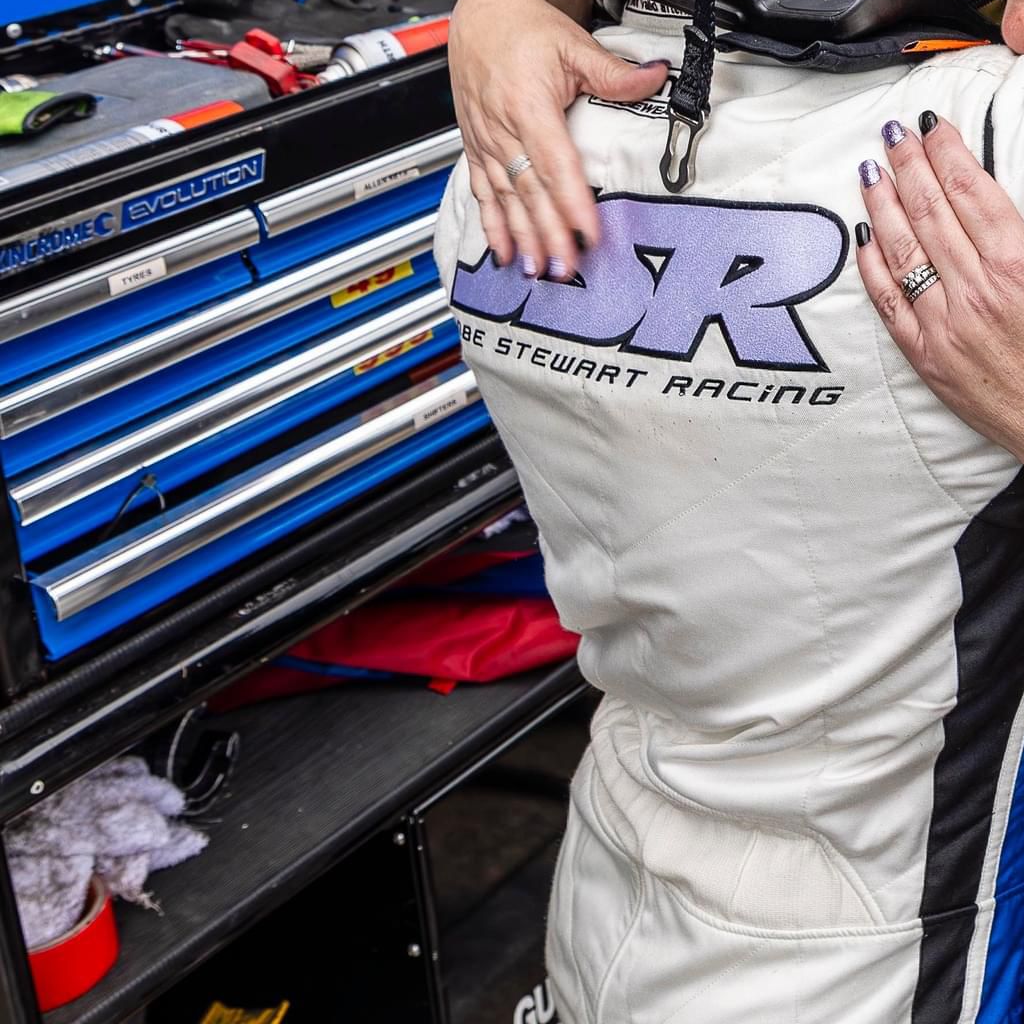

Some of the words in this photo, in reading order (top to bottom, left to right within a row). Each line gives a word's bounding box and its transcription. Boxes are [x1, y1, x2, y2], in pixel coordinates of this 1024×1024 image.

[128, 159, 258, 221] EVOLUTION
[494, 337, 649, 389] STEWART
[661, 375, 846, 407] RACING
